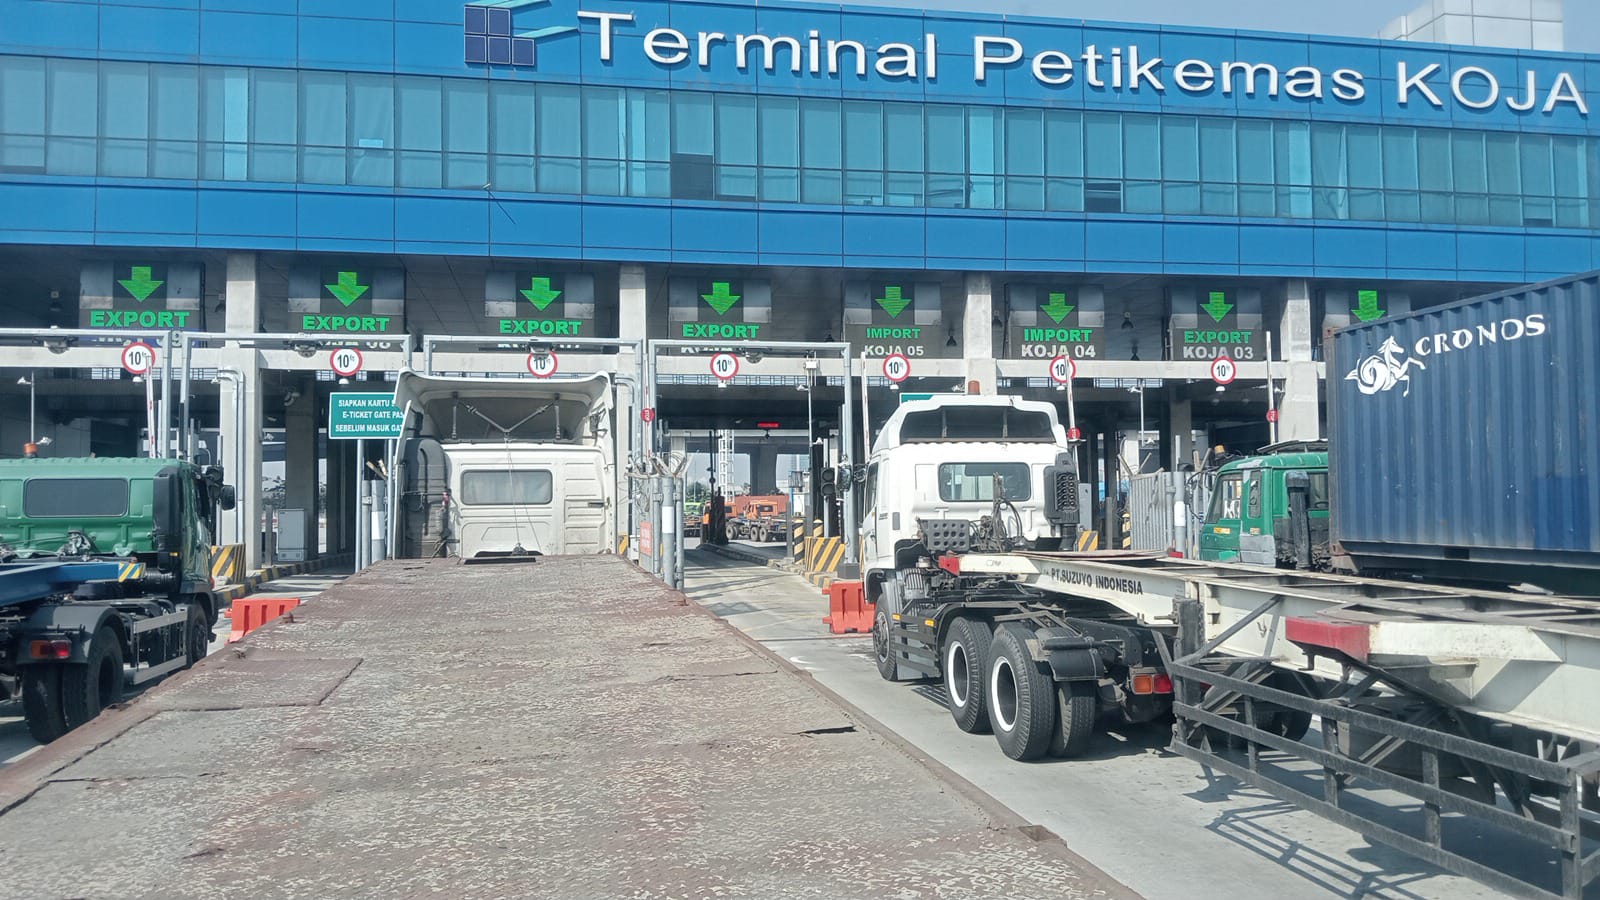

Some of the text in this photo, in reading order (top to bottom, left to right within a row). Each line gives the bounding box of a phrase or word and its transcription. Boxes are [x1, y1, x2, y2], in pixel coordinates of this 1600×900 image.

[577, 11, 1588, 114] Terminal Petikemas KOJA
[90, 310, 190, 328] EXPORT
[302, 315, 390, 332] EXPORT
[500, 320, 582, 335] EXPORT
[682, 324, 759, 338] EXPORT
[866, 328, 920, 339] IMPORT
[1023, 329, 1092, 342] IMPORT
[1184, 331, 1251, 343] EXPORT
[1415, 314, 1546, 356] CRONOS
[864, 345, 924, 356] KOJA 05
[1021, 345, 1096, 358] KOJA 04
[1183, 346, 1254, 359] KOJA 03
[1056, 364, 1065, 376] 10
[342, 411, 373, 419] E-TICKET
[374, 411, 391, 419] GATE
[335, 424, 366, 432] SEBELUM
[366, 424, 390, 432] MASUK
[1051, 567, 1143, 595] PT.SUZUYO INDONESIA
